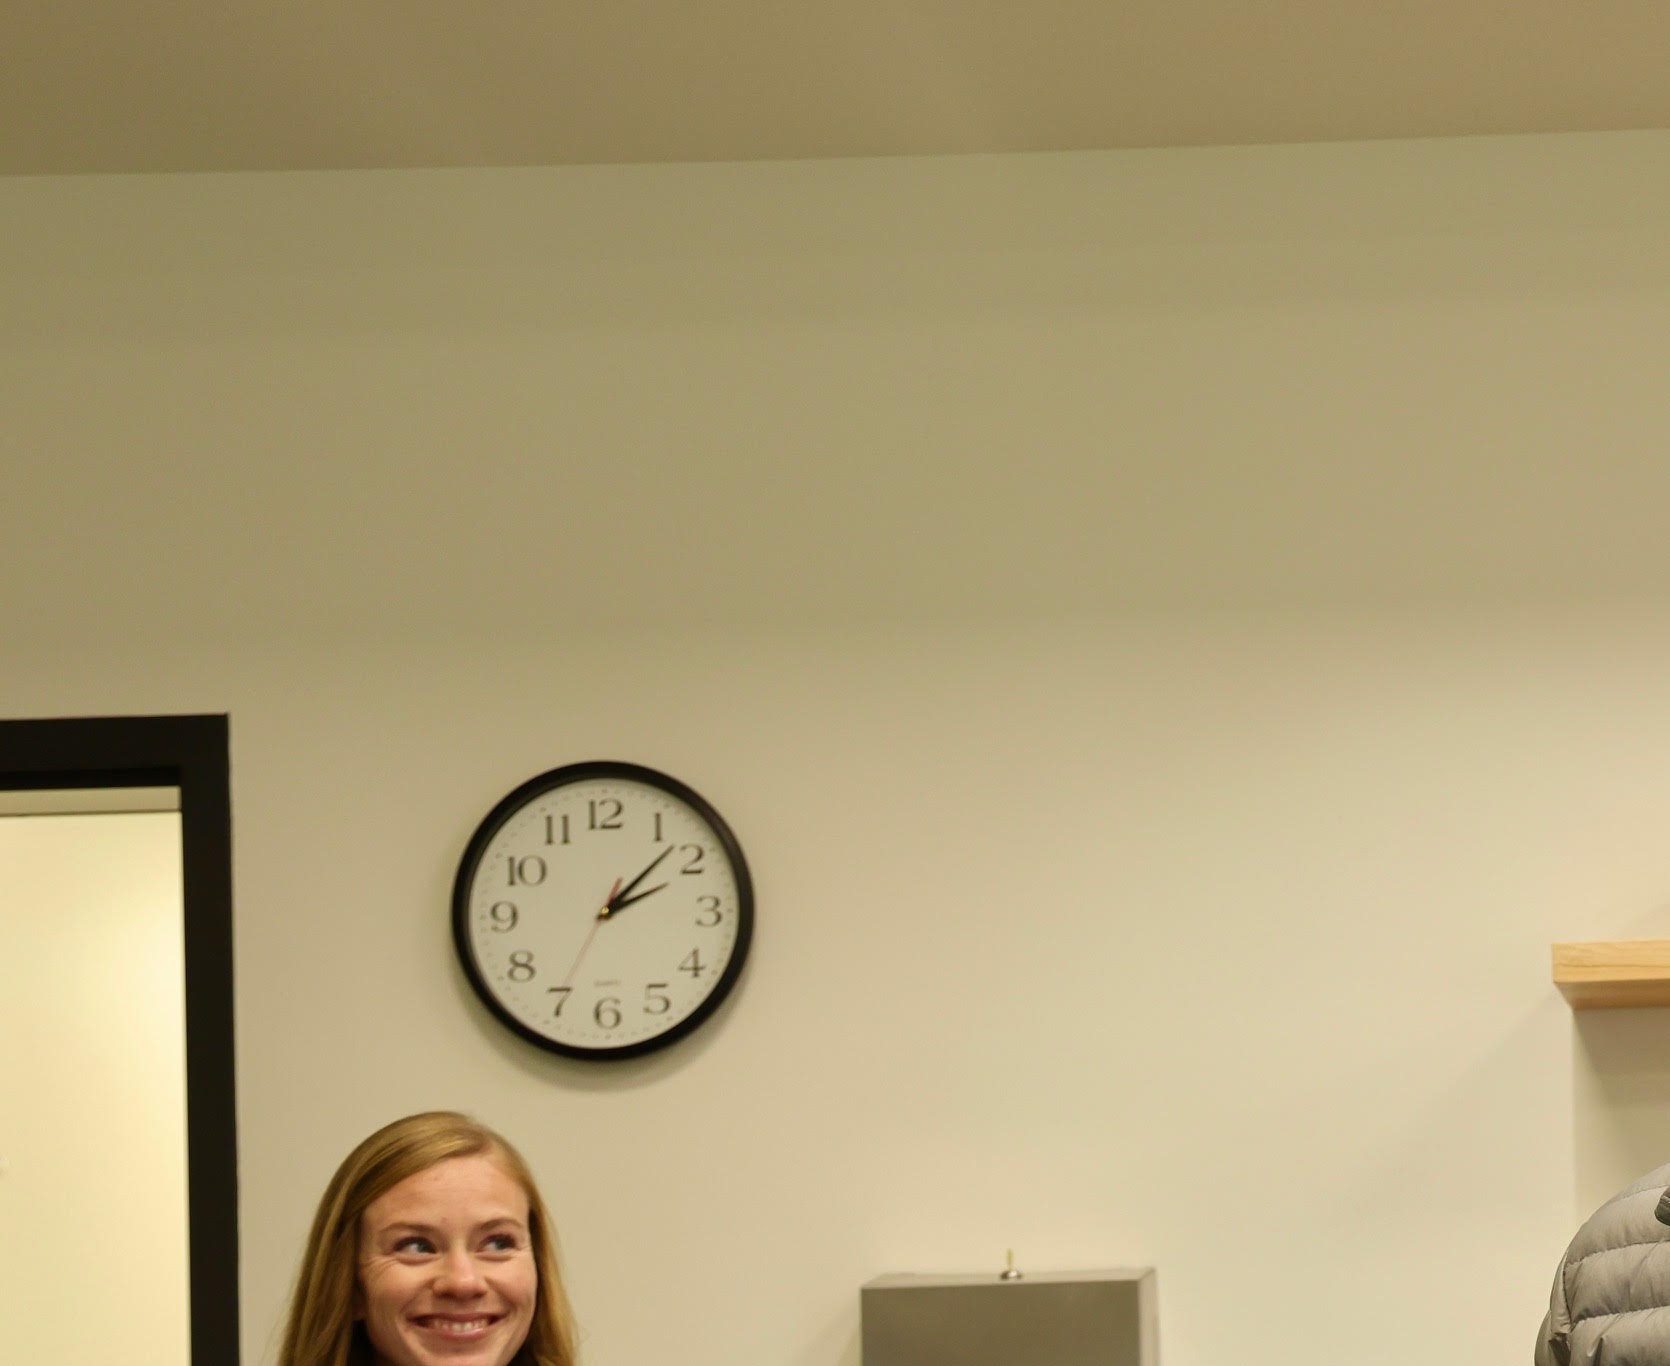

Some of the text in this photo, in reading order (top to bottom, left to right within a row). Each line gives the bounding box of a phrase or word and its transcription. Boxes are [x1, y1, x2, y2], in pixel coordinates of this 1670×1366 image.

[544, 814, 571, 845] 11
[588, 798, 624, 831] 12
[653, 812, 663, 842] 1
[508, 854, 548, 886] 10
[680, 844, 705, 875] 2
[490, 900, 519, 933] 9
[695, 895, 723, 927] 3
[507, 950, 536, 983] 8
[678, 949, 706, 978] 4
[546, 986, 573, 1017] 7
[593, 997, 622, 1029] 6
[643, 983, 671, 1015] 5
